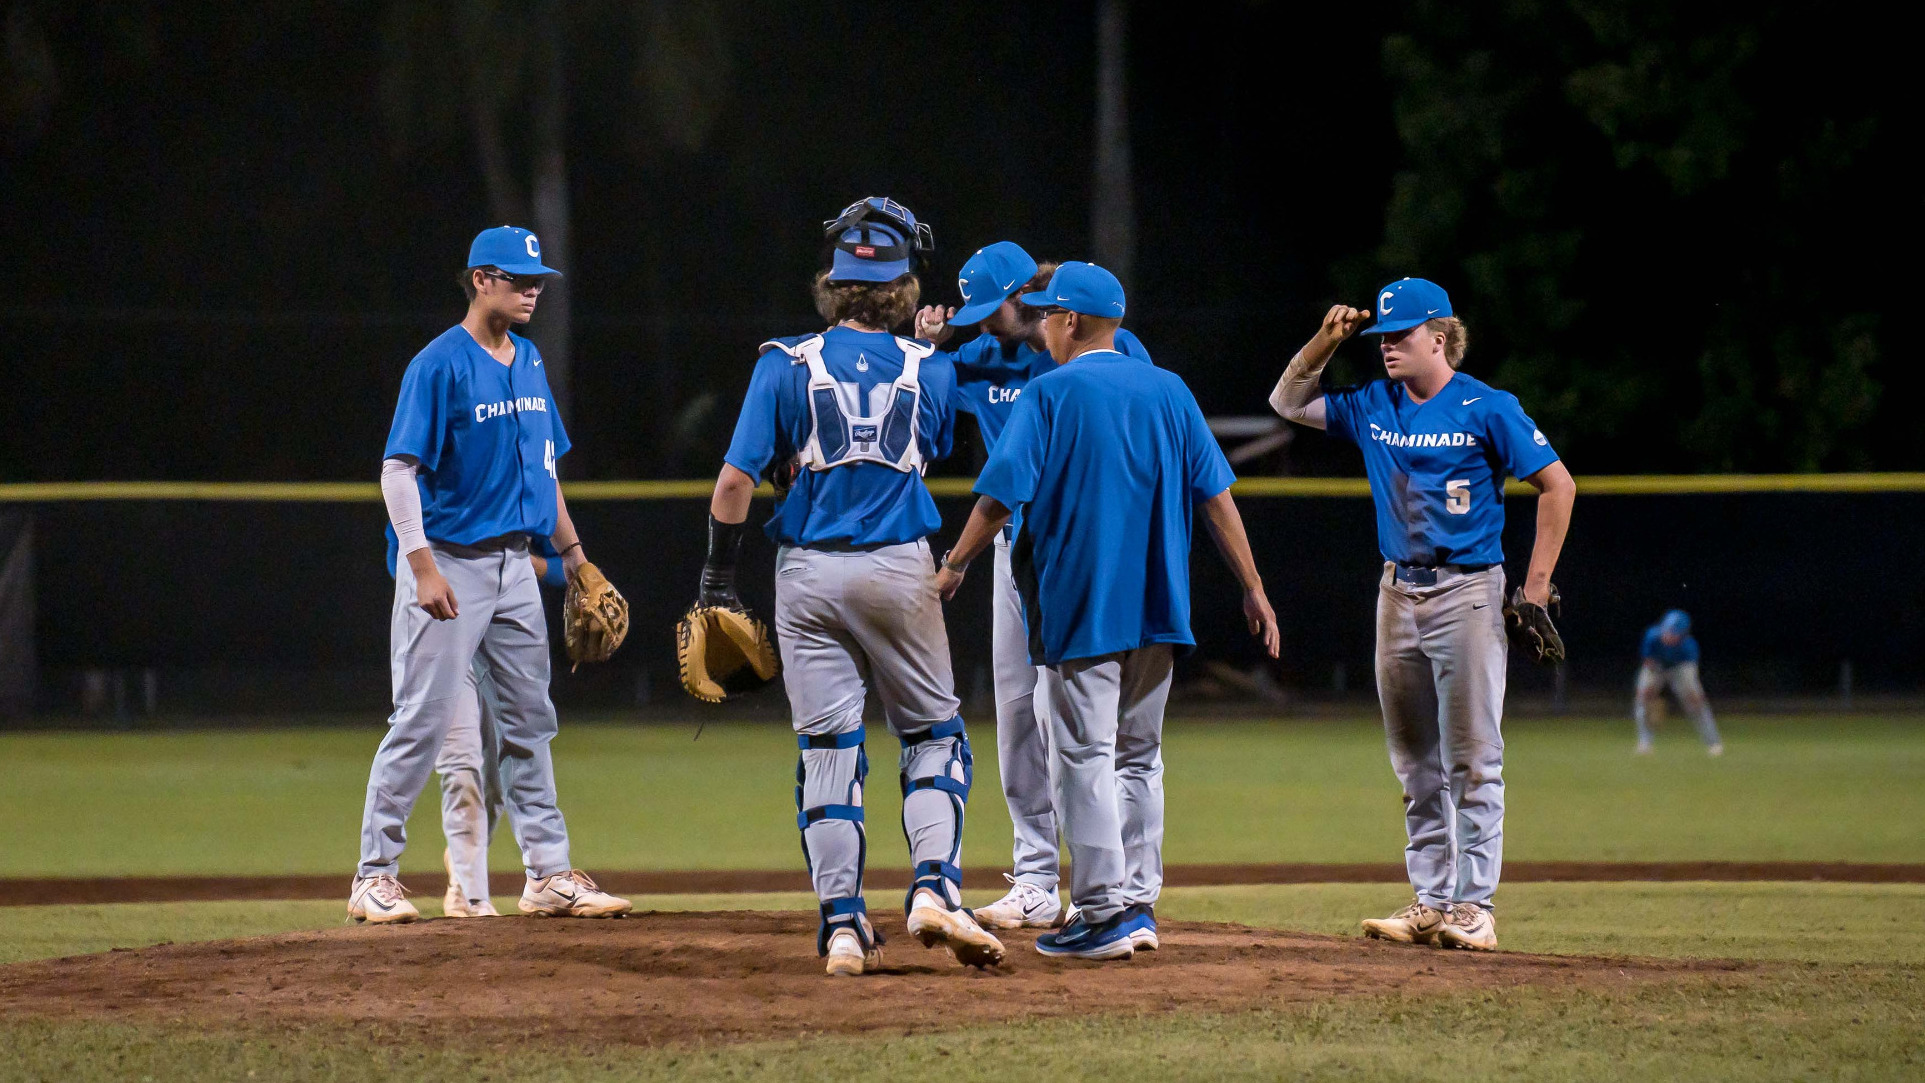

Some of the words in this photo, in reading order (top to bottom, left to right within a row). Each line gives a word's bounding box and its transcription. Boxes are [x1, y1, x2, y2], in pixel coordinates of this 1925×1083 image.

[525, 235, 539, 258] C
[1380, 291, 1395, 316] C
[475, 396, 547, 423] CHAMINADE
[1369, 423, 1477, 448] CHAMINADE
[543, 438, 558, 480] 4
[1445, 478, 1471, 515] 5
